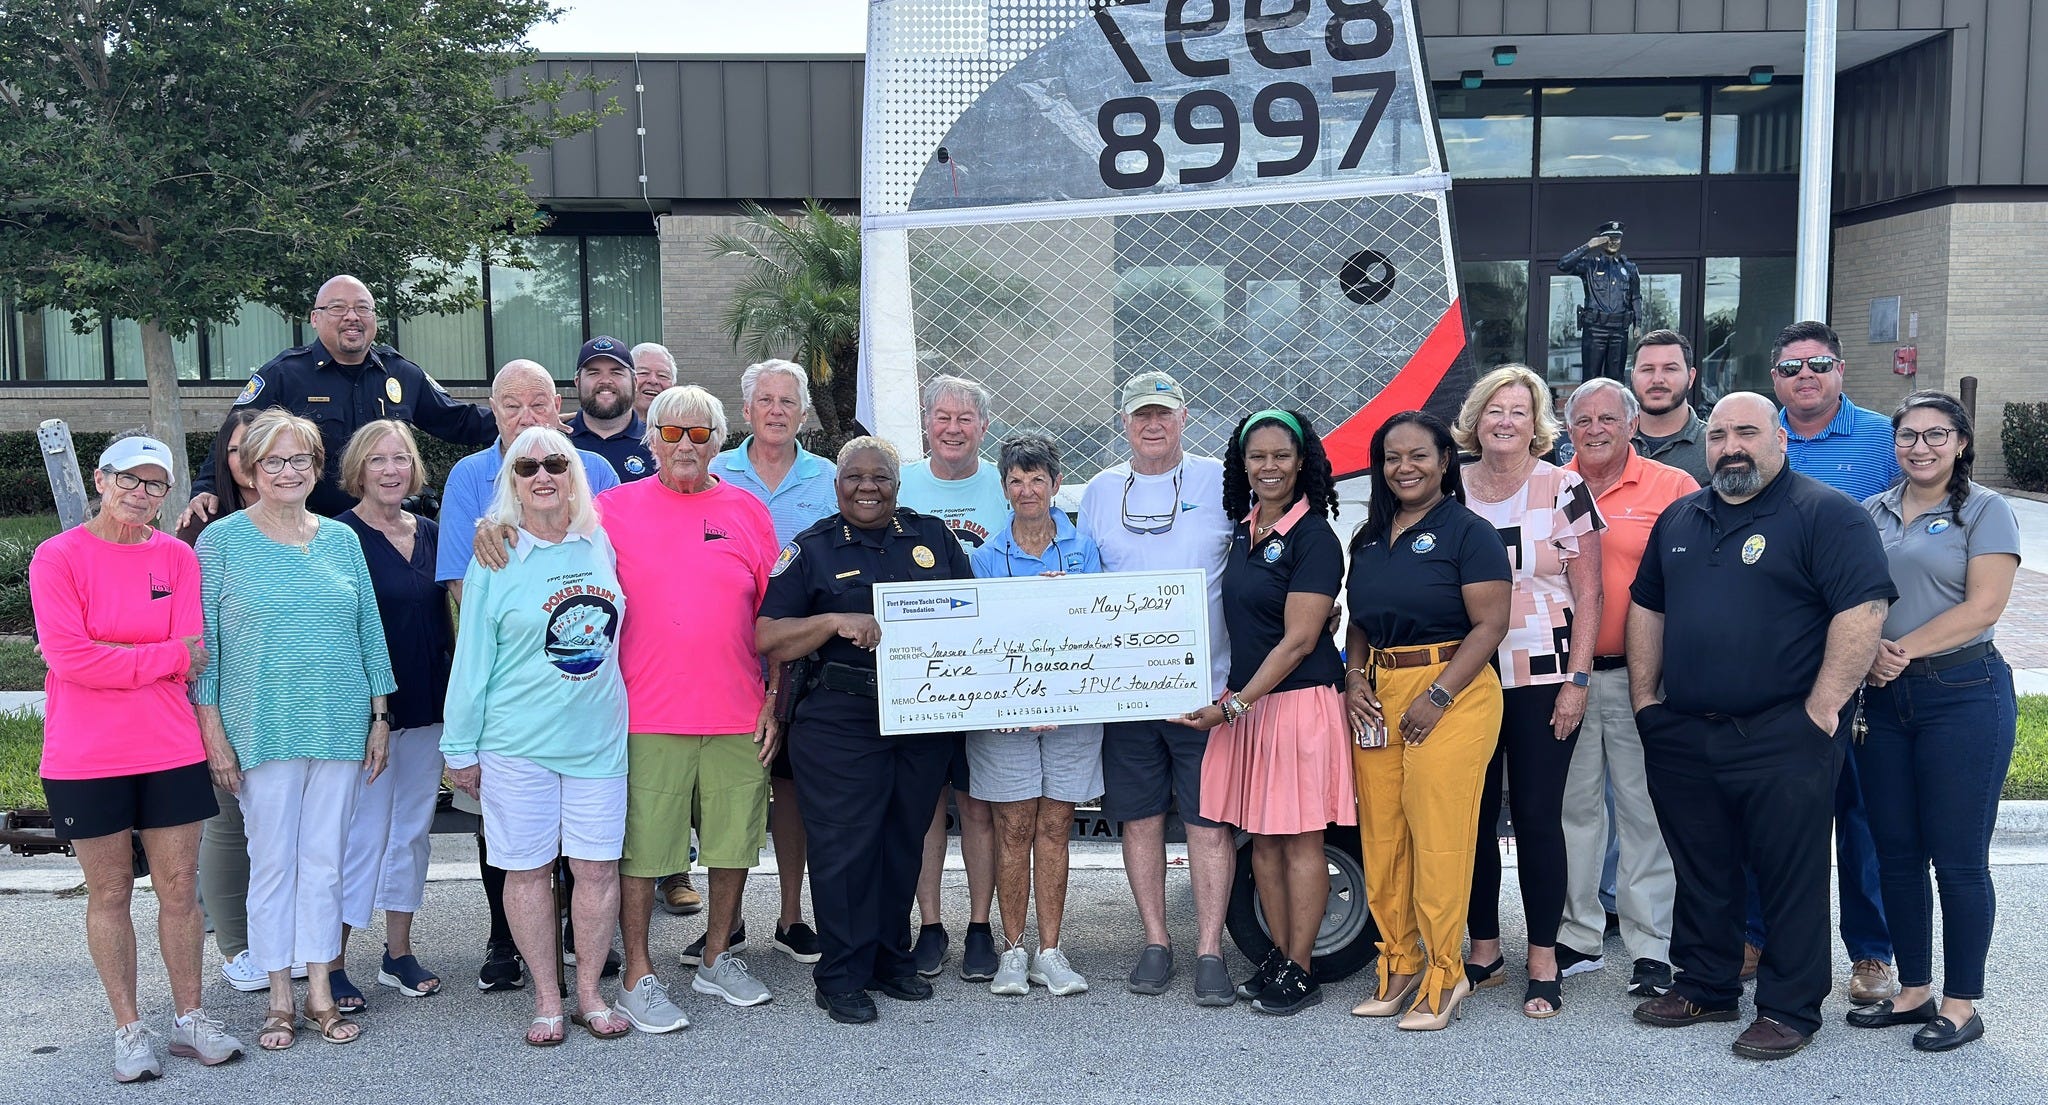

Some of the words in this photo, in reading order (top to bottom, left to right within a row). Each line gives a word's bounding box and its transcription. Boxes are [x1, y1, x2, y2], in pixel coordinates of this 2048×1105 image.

[1097, 70, 1396, 190] 8997
[963, 519, 990, 539] RUN
[562, 571, 592, 579] FOUNDATION
[1158, 584, 1185, 596] 1001
[541, 584, 583, 614] POKER
[586, 584, 616, 602] RUN
[902, 606, 935, 614] Foundation
[1069, 607, 1087, 615] DATE
[1091, 595, 1122, 621] May
[972, 638, 1000, 655] Coast
[1126, 633, 1180, 647] 5,000
[889, 653, 911, 661] ORDER
[1148, 658, 1181, 667] DOLLARS
[926, 659, 978, 678] Five
[1005, 653, 1095, 673] Thousand
[571, 673, 581, 681] the
[582, 670, 598, 681] water
[1123, 672, 1198, 690] Foundation
[916, 682, 1008, 710] Courageous
[1011, 677, 1047, 698] Kids
[891, 698, 915, 706] MEMO
